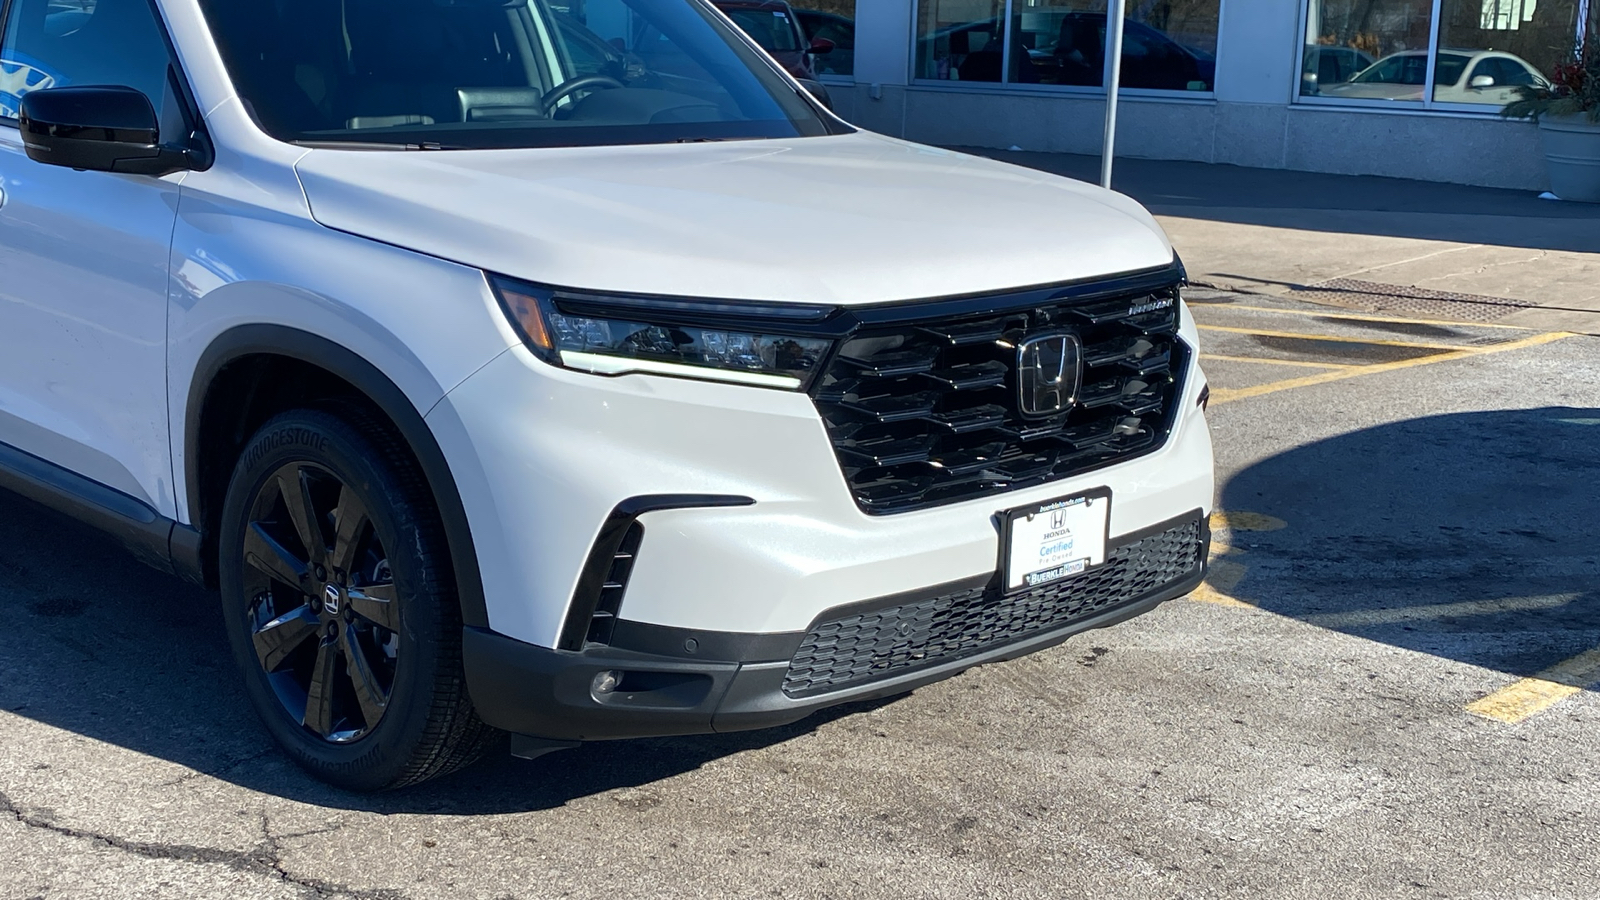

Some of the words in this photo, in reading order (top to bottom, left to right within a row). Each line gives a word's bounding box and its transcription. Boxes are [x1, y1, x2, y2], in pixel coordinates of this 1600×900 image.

[243, 427, 330, 470] BRIDGESTONE
[1043, 528, 1071, 540] HONDA
[1040, 539, 1074, 556] Certified
